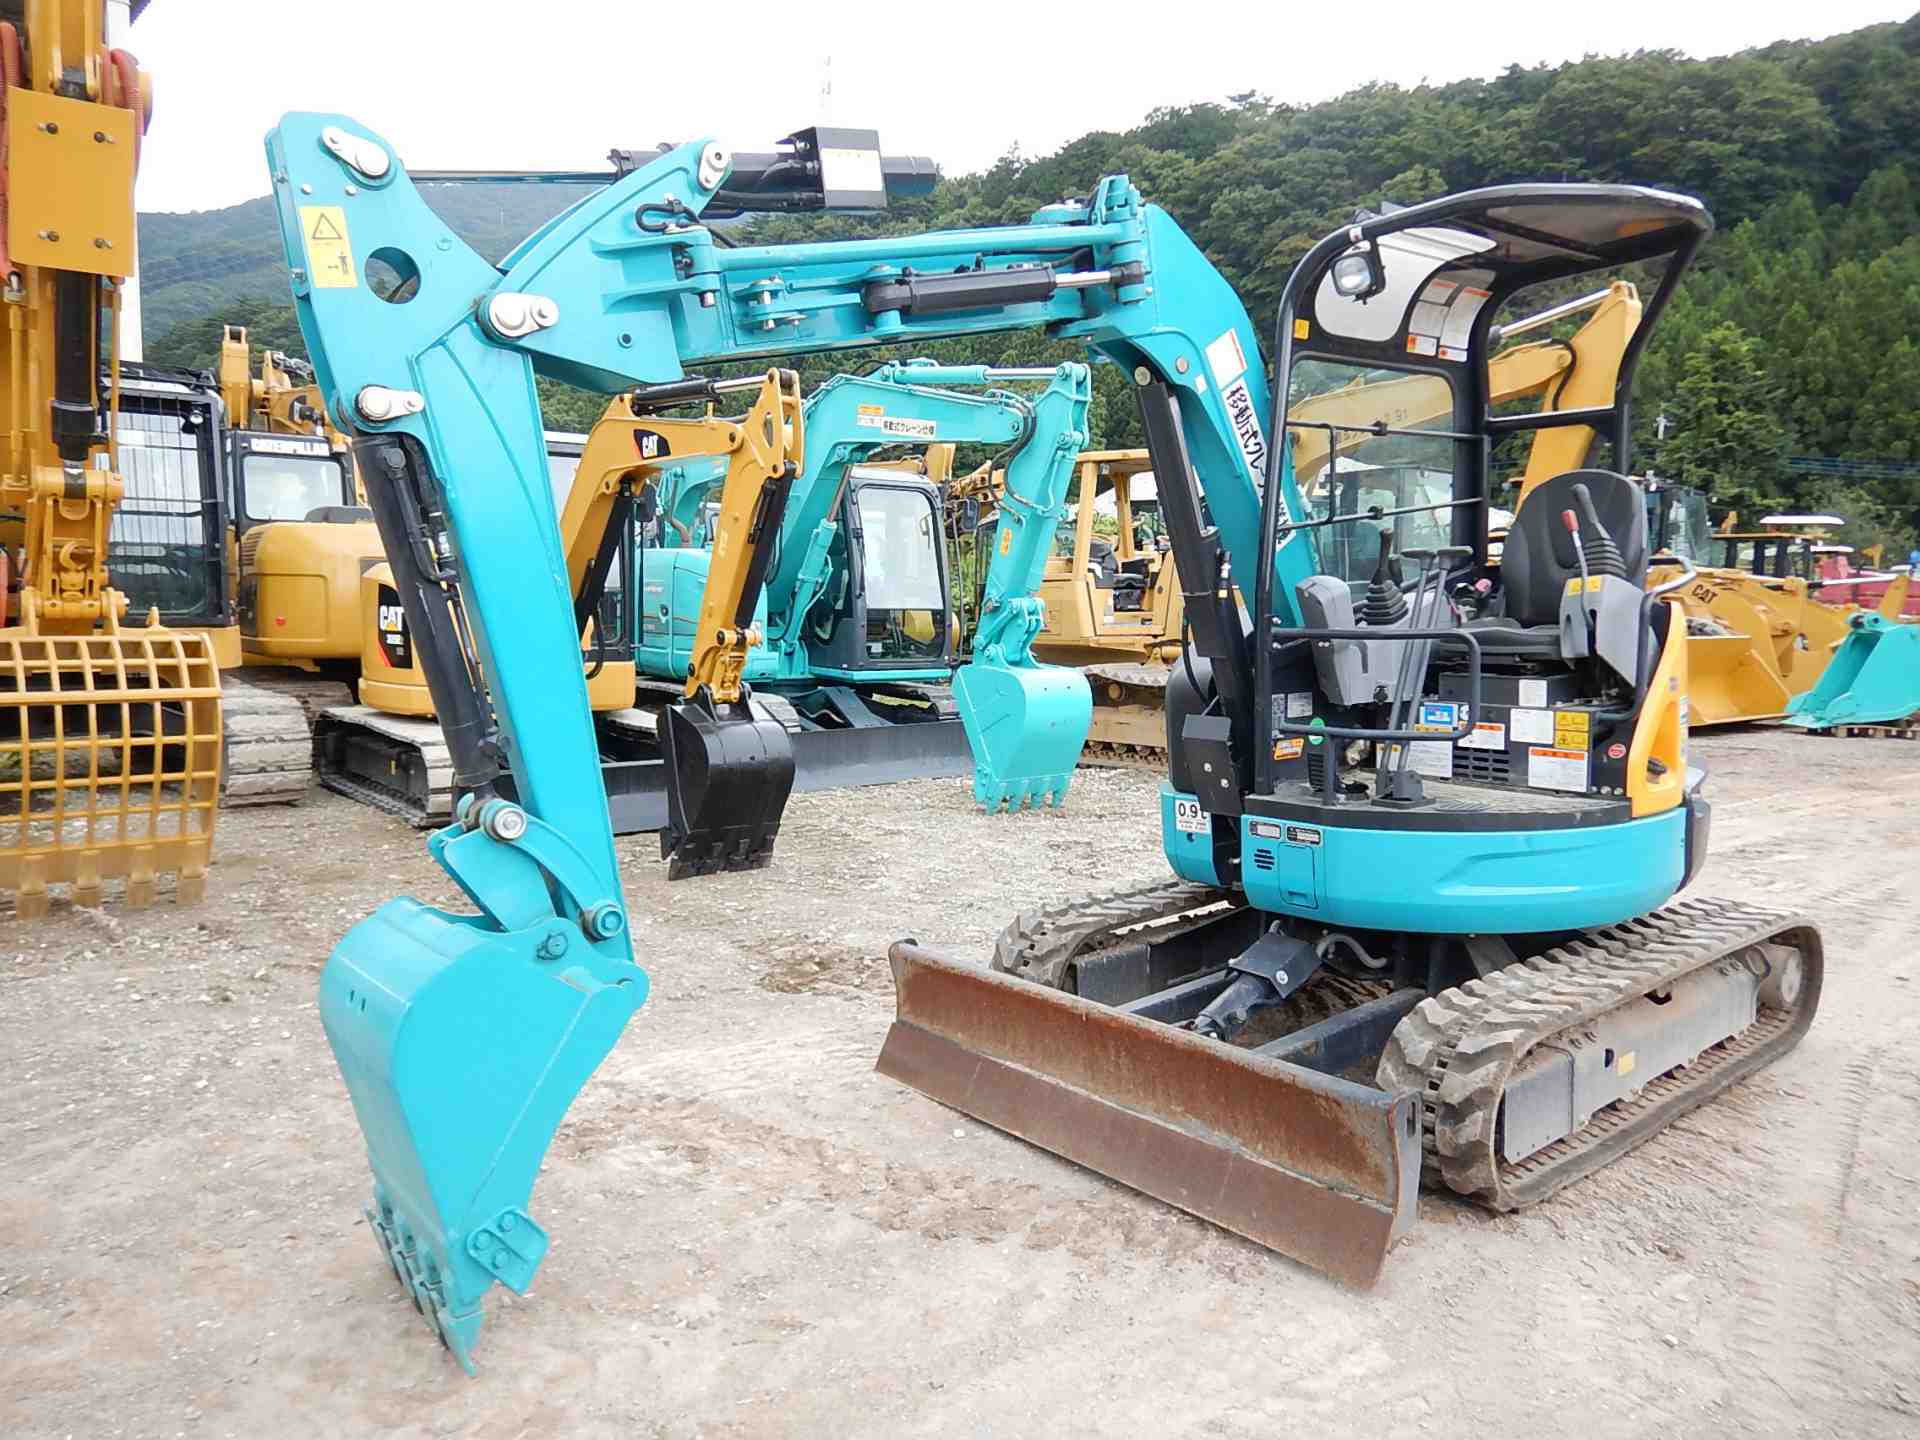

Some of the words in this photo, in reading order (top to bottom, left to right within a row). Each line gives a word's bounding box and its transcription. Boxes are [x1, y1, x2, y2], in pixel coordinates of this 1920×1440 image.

[642, 435, 658, 458] CAT
[1692, 584, 1717, 604] CAT
[379, 605, 404, 631] CAT
